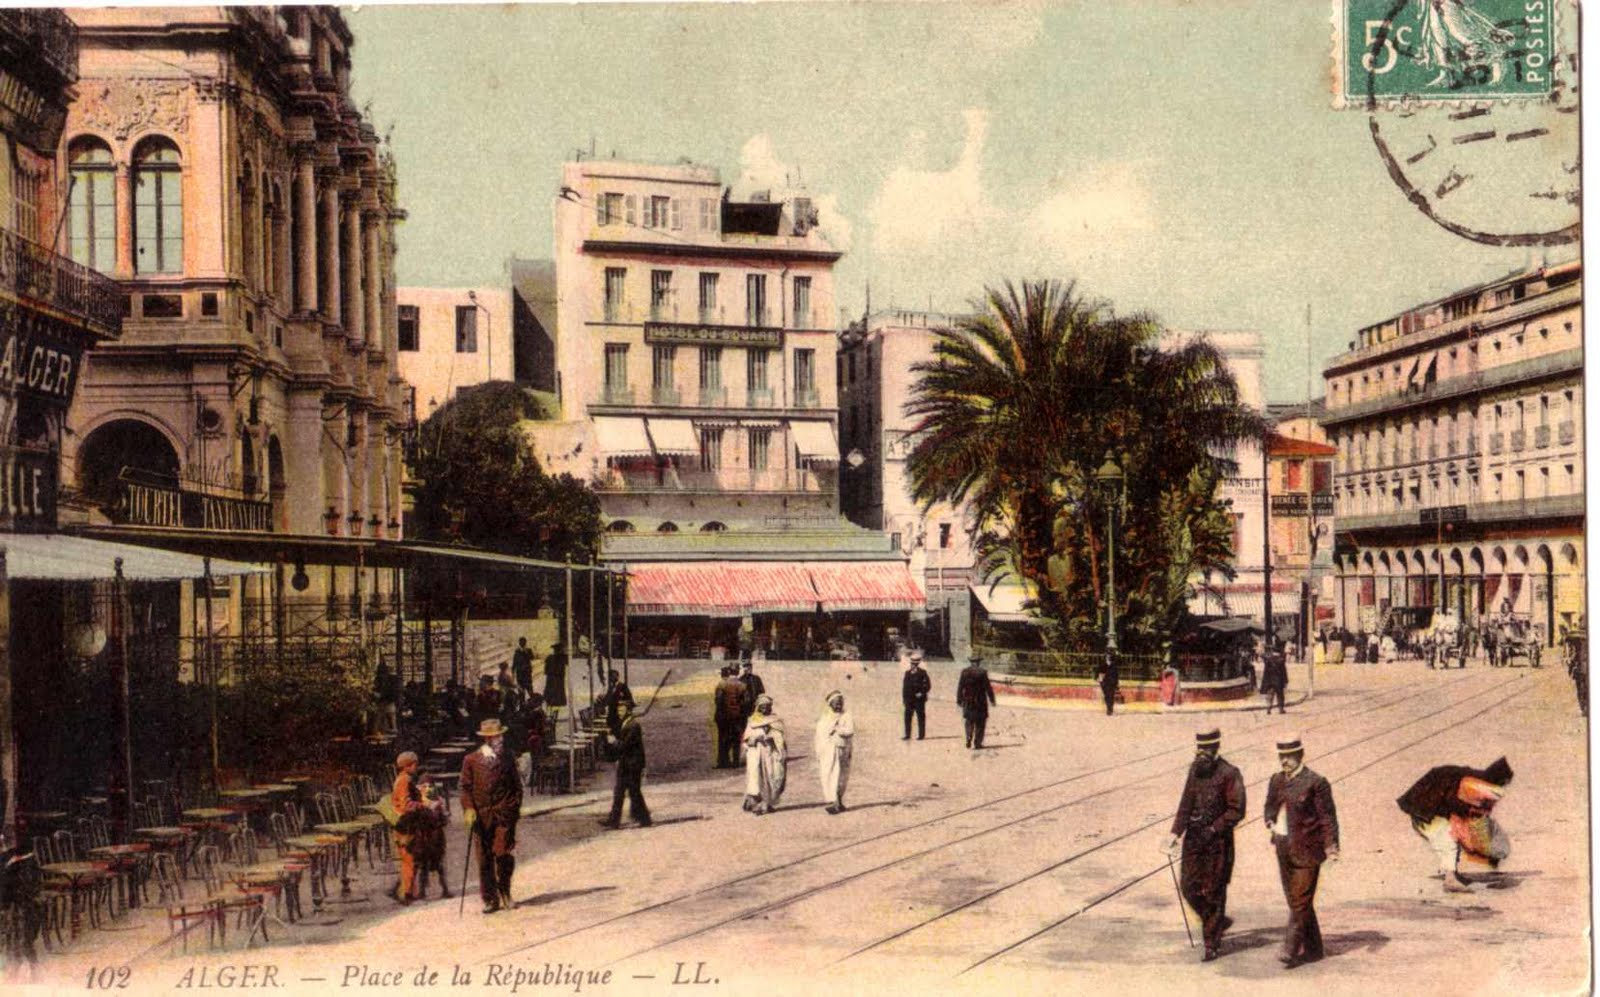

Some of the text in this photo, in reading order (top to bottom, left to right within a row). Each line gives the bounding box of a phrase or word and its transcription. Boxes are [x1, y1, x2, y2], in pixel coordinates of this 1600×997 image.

[0, 335, 72, 396] ALGER
[0, 460, 43, 516] LLE
[128, 484, 184, 528] TOURTEL
